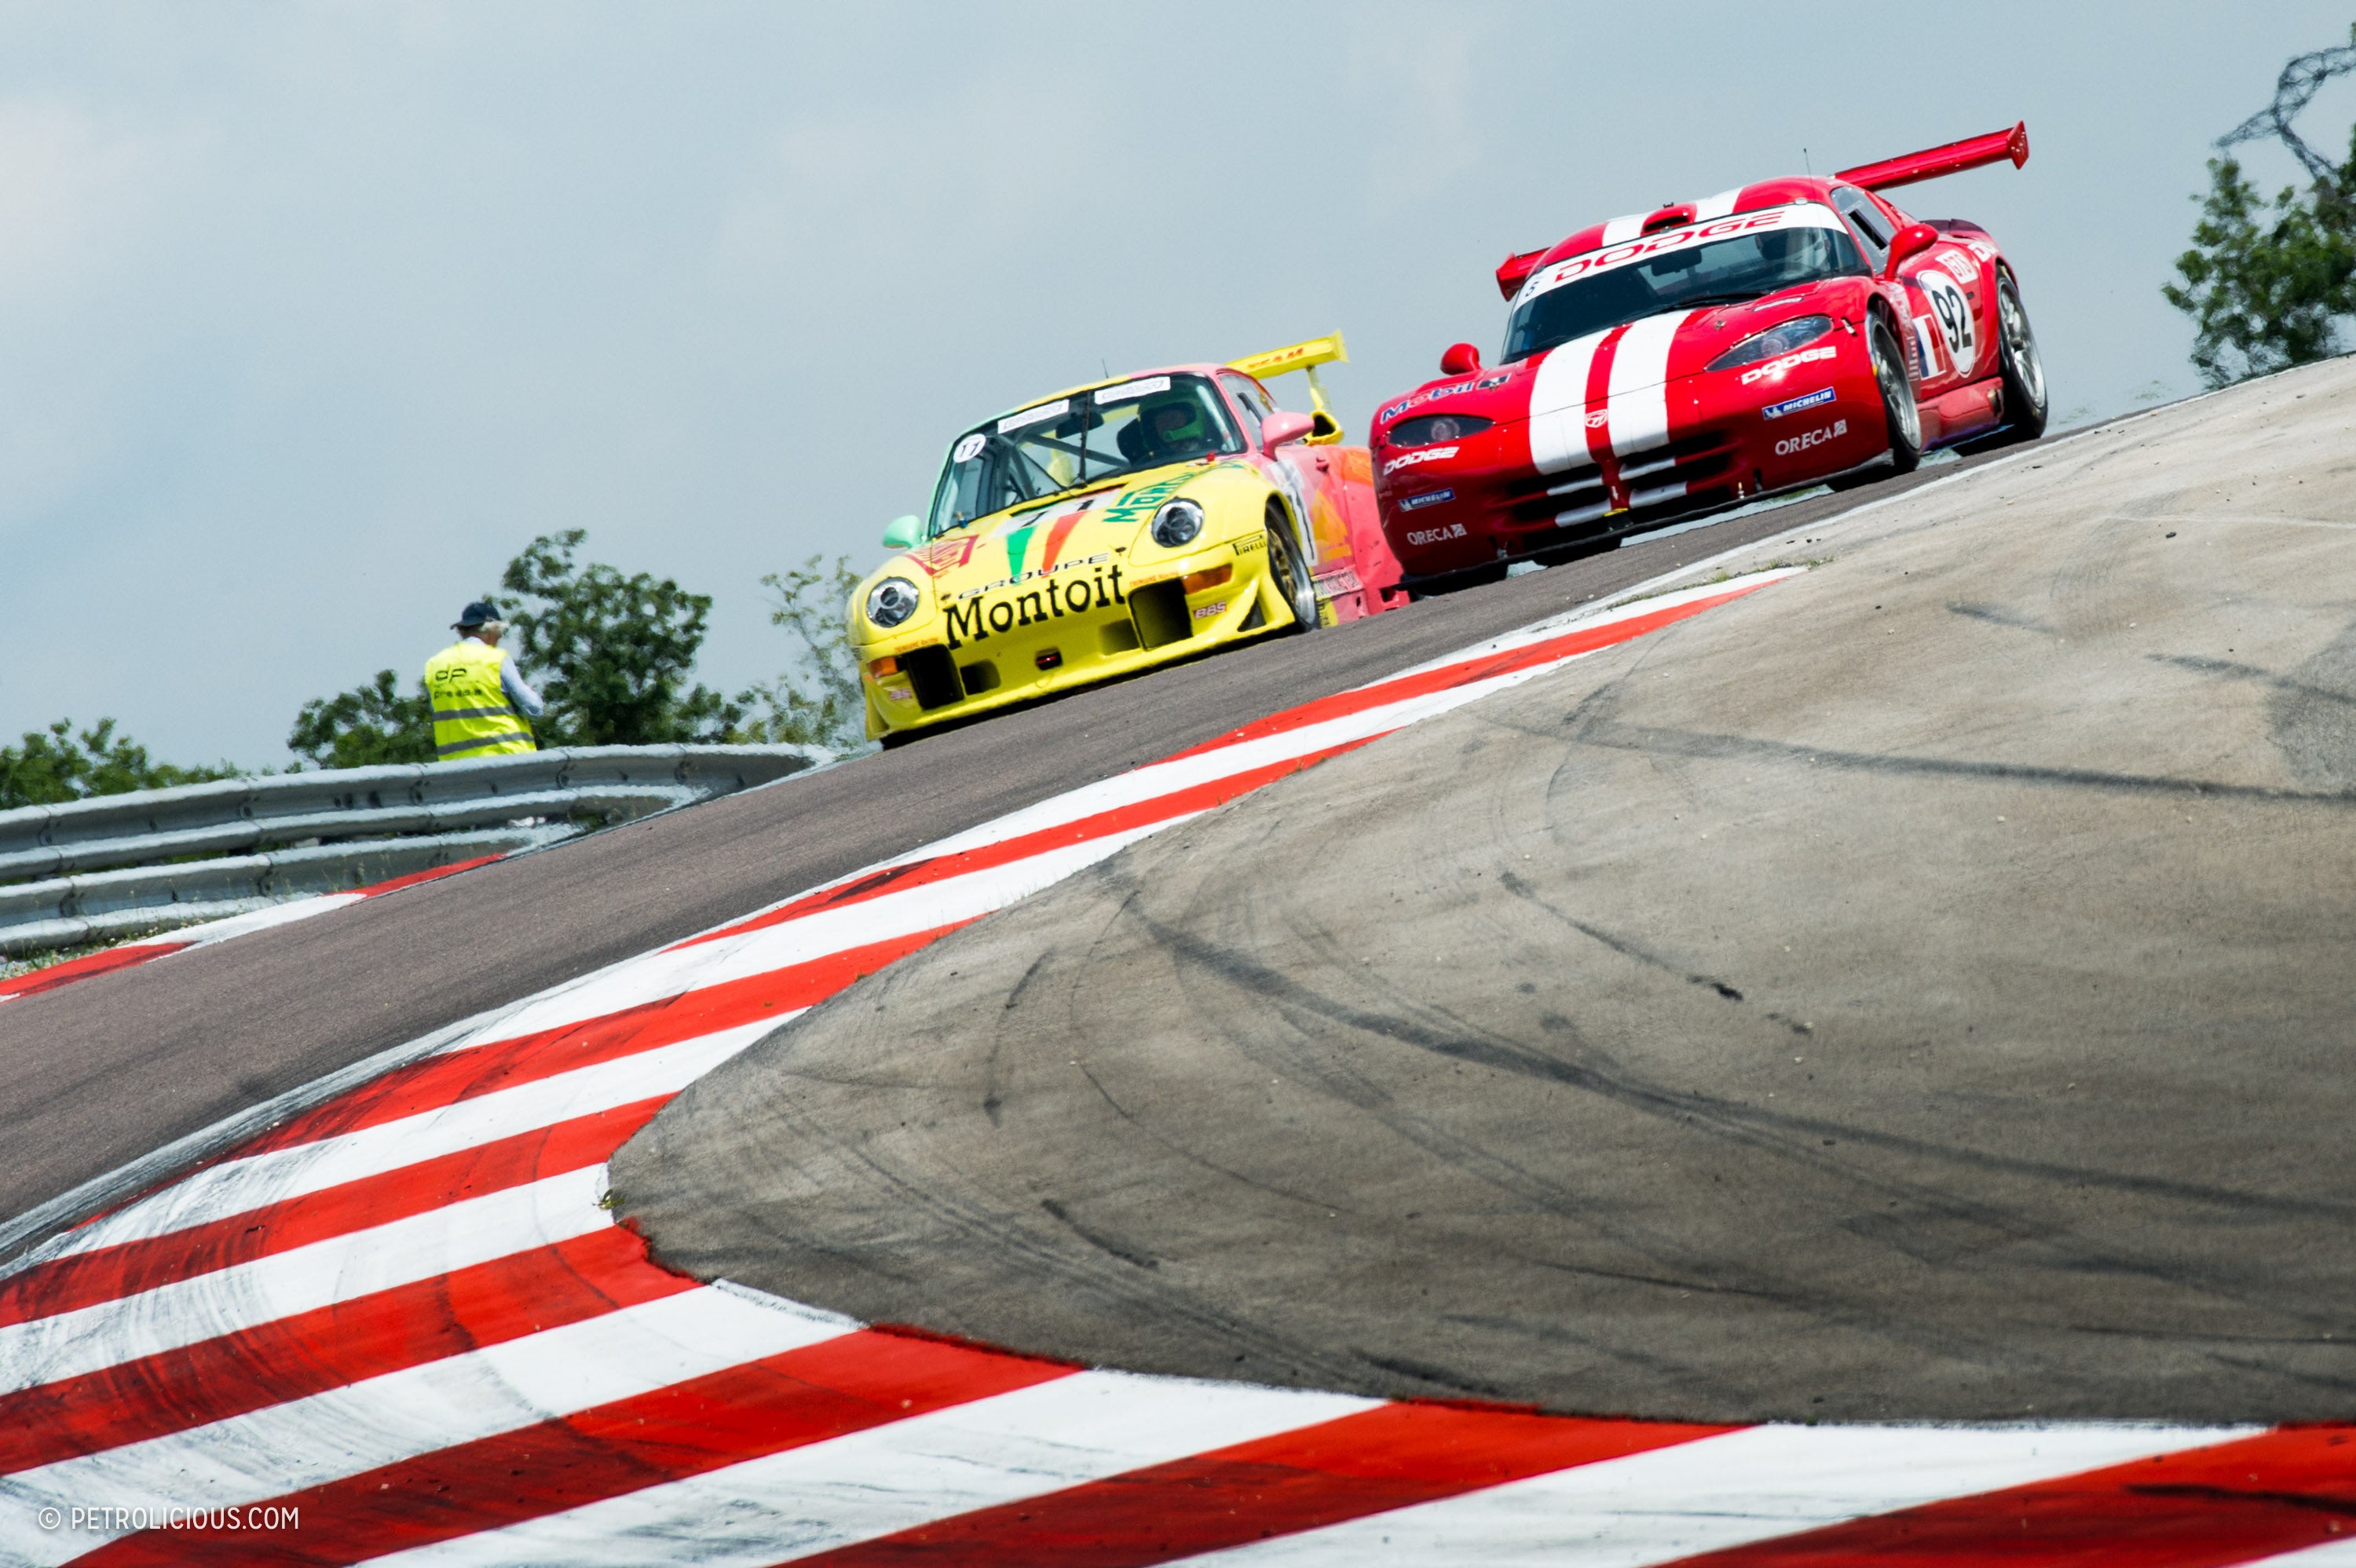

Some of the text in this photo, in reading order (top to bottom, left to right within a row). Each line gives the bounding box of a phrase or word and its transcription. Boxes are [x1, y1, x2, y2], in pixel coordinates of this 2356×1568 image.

[1554, 211, 1785, 283] DODGE
[1931, 284, 1973, 353] 92
[1740, 345, 1837, 386] DODGE
[1380, 382, 1474, 424] Mobil
[1783, 391, 1831, 412] MICHELIN
[1775, 426, 1833, 455] ORECA
[1383, 446, 1460, 476] DODGE
[1410, 489, 1452, 506] MICHELIN
[1232, 535, 1267, 556] PIRELLI
[1407, 526, 1453, 545] ORECA
[958, 553, 1109, 600] GROUPE
[942, 565, 1126, 650] Montoit
[1194, 601, 1227, 619] BBS
